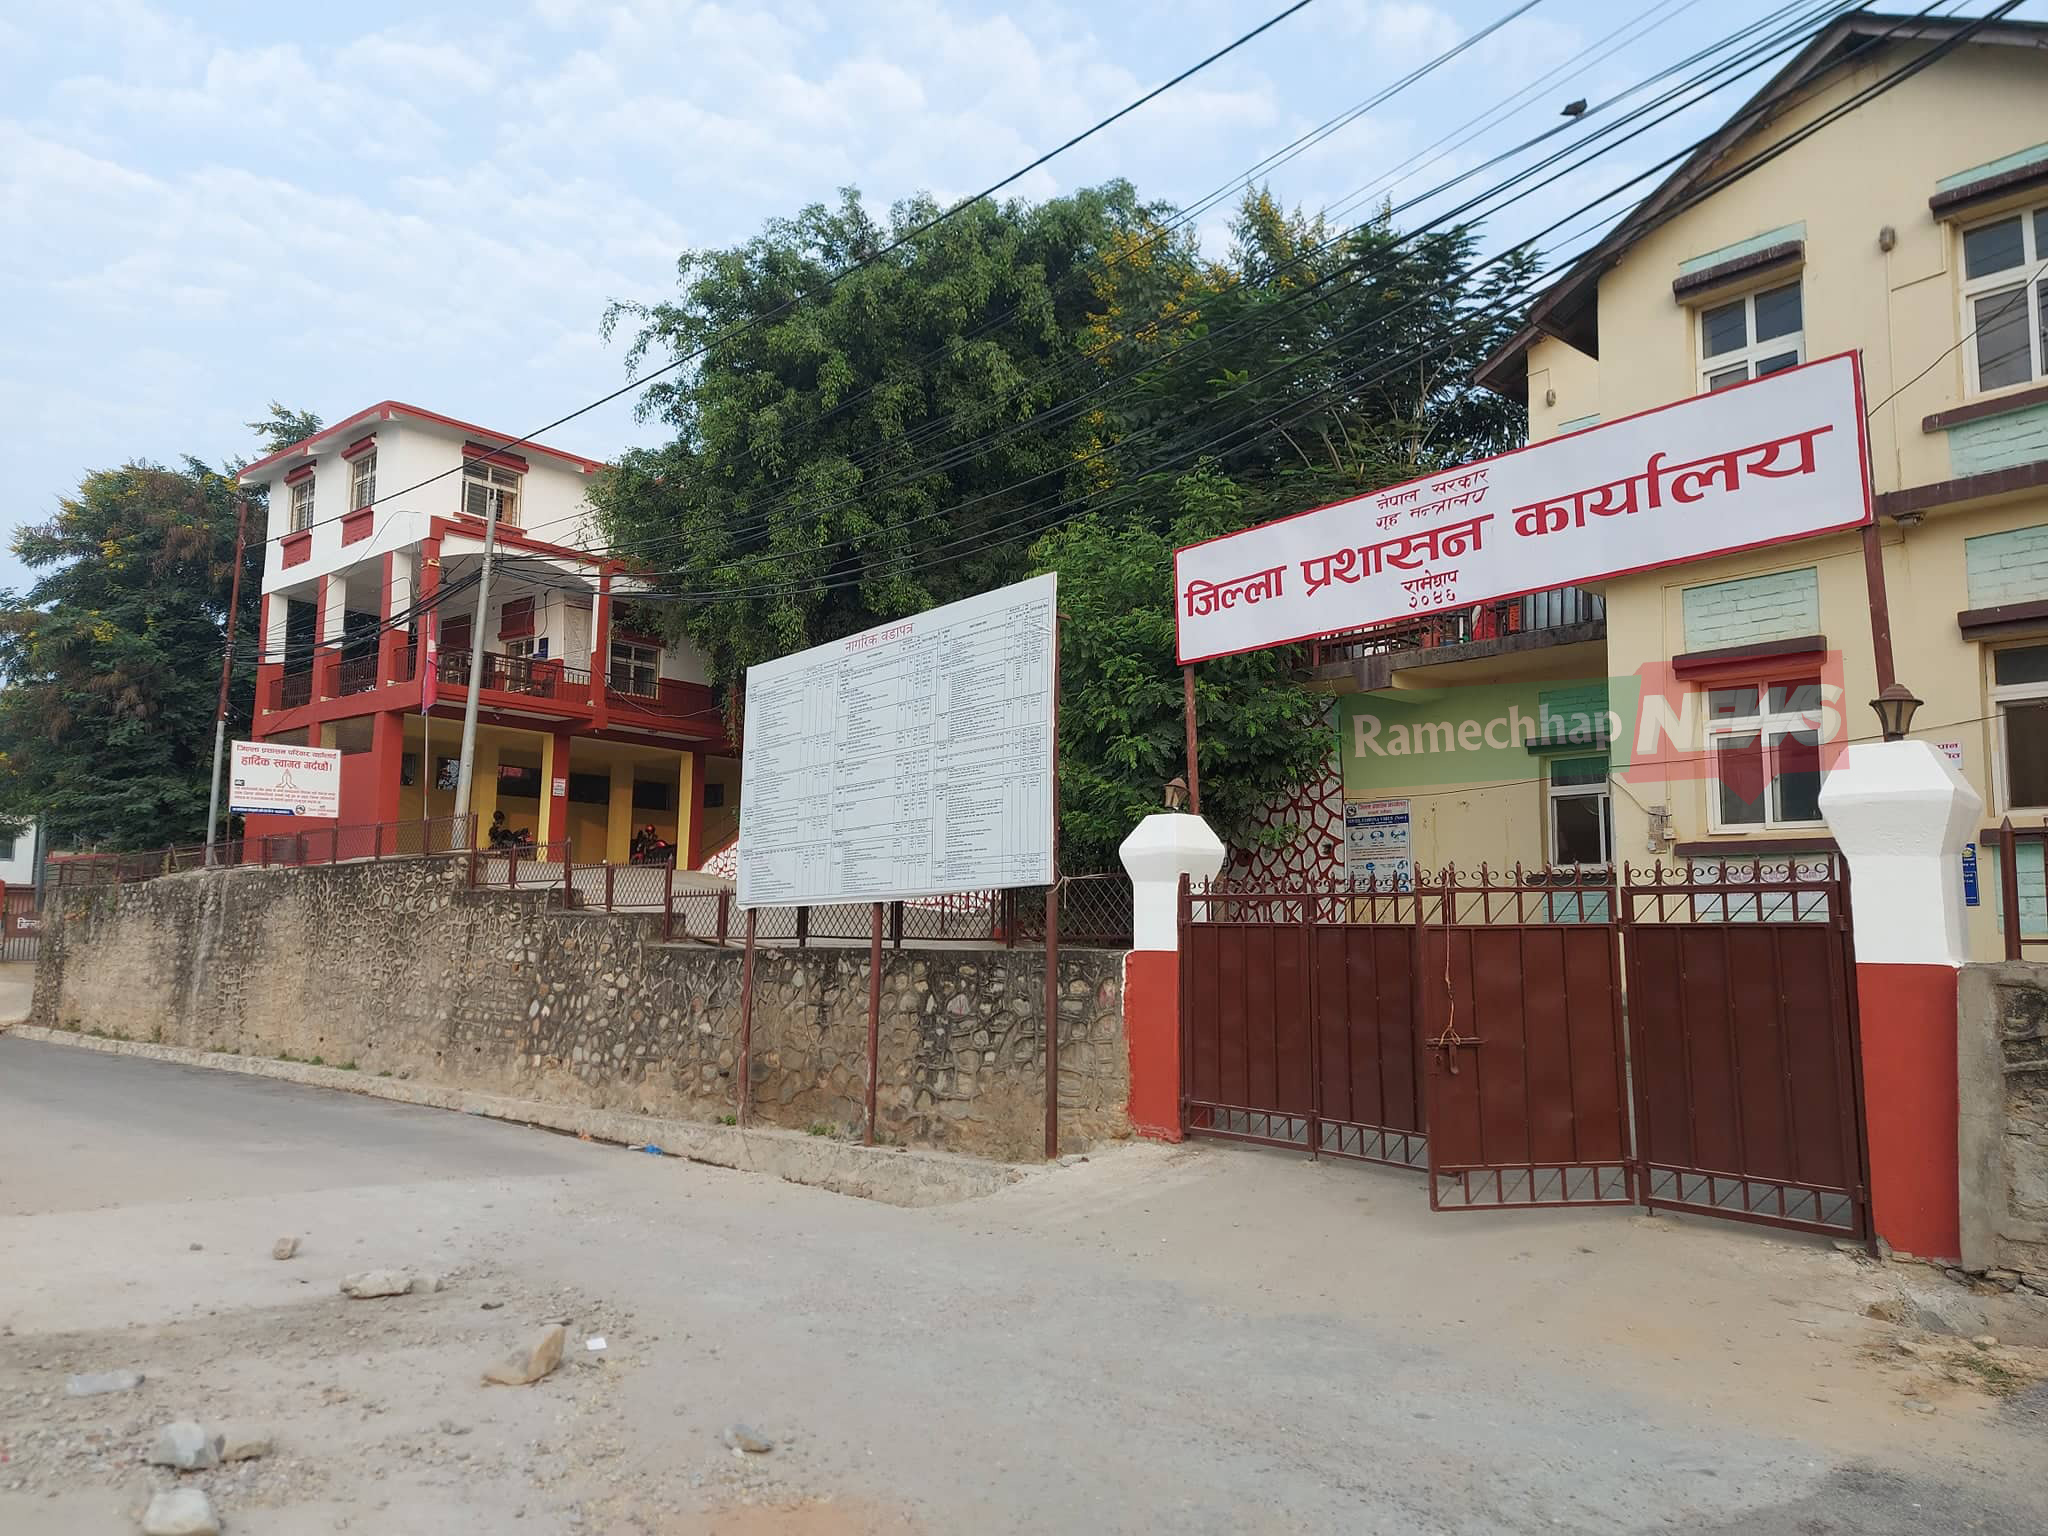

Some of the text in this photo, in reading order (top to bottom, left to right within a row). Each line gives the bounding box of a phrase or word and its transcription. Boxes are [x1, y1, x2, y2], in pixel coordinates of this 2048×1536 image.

[1376, 468, 1490, 509] नेपाल सरकार
[1183, 424, 1834, 617] जिल्ला प्रशासन कार्यालय
[1375, 511, 1402, 530] गृह
[1400, 569, 1460, 595] रामेछाप
[844, 633, 879, 653] नागरिक
[240, 754, 270, 767] हार्दिक
[273, 758, 301, 769] स्वागत
